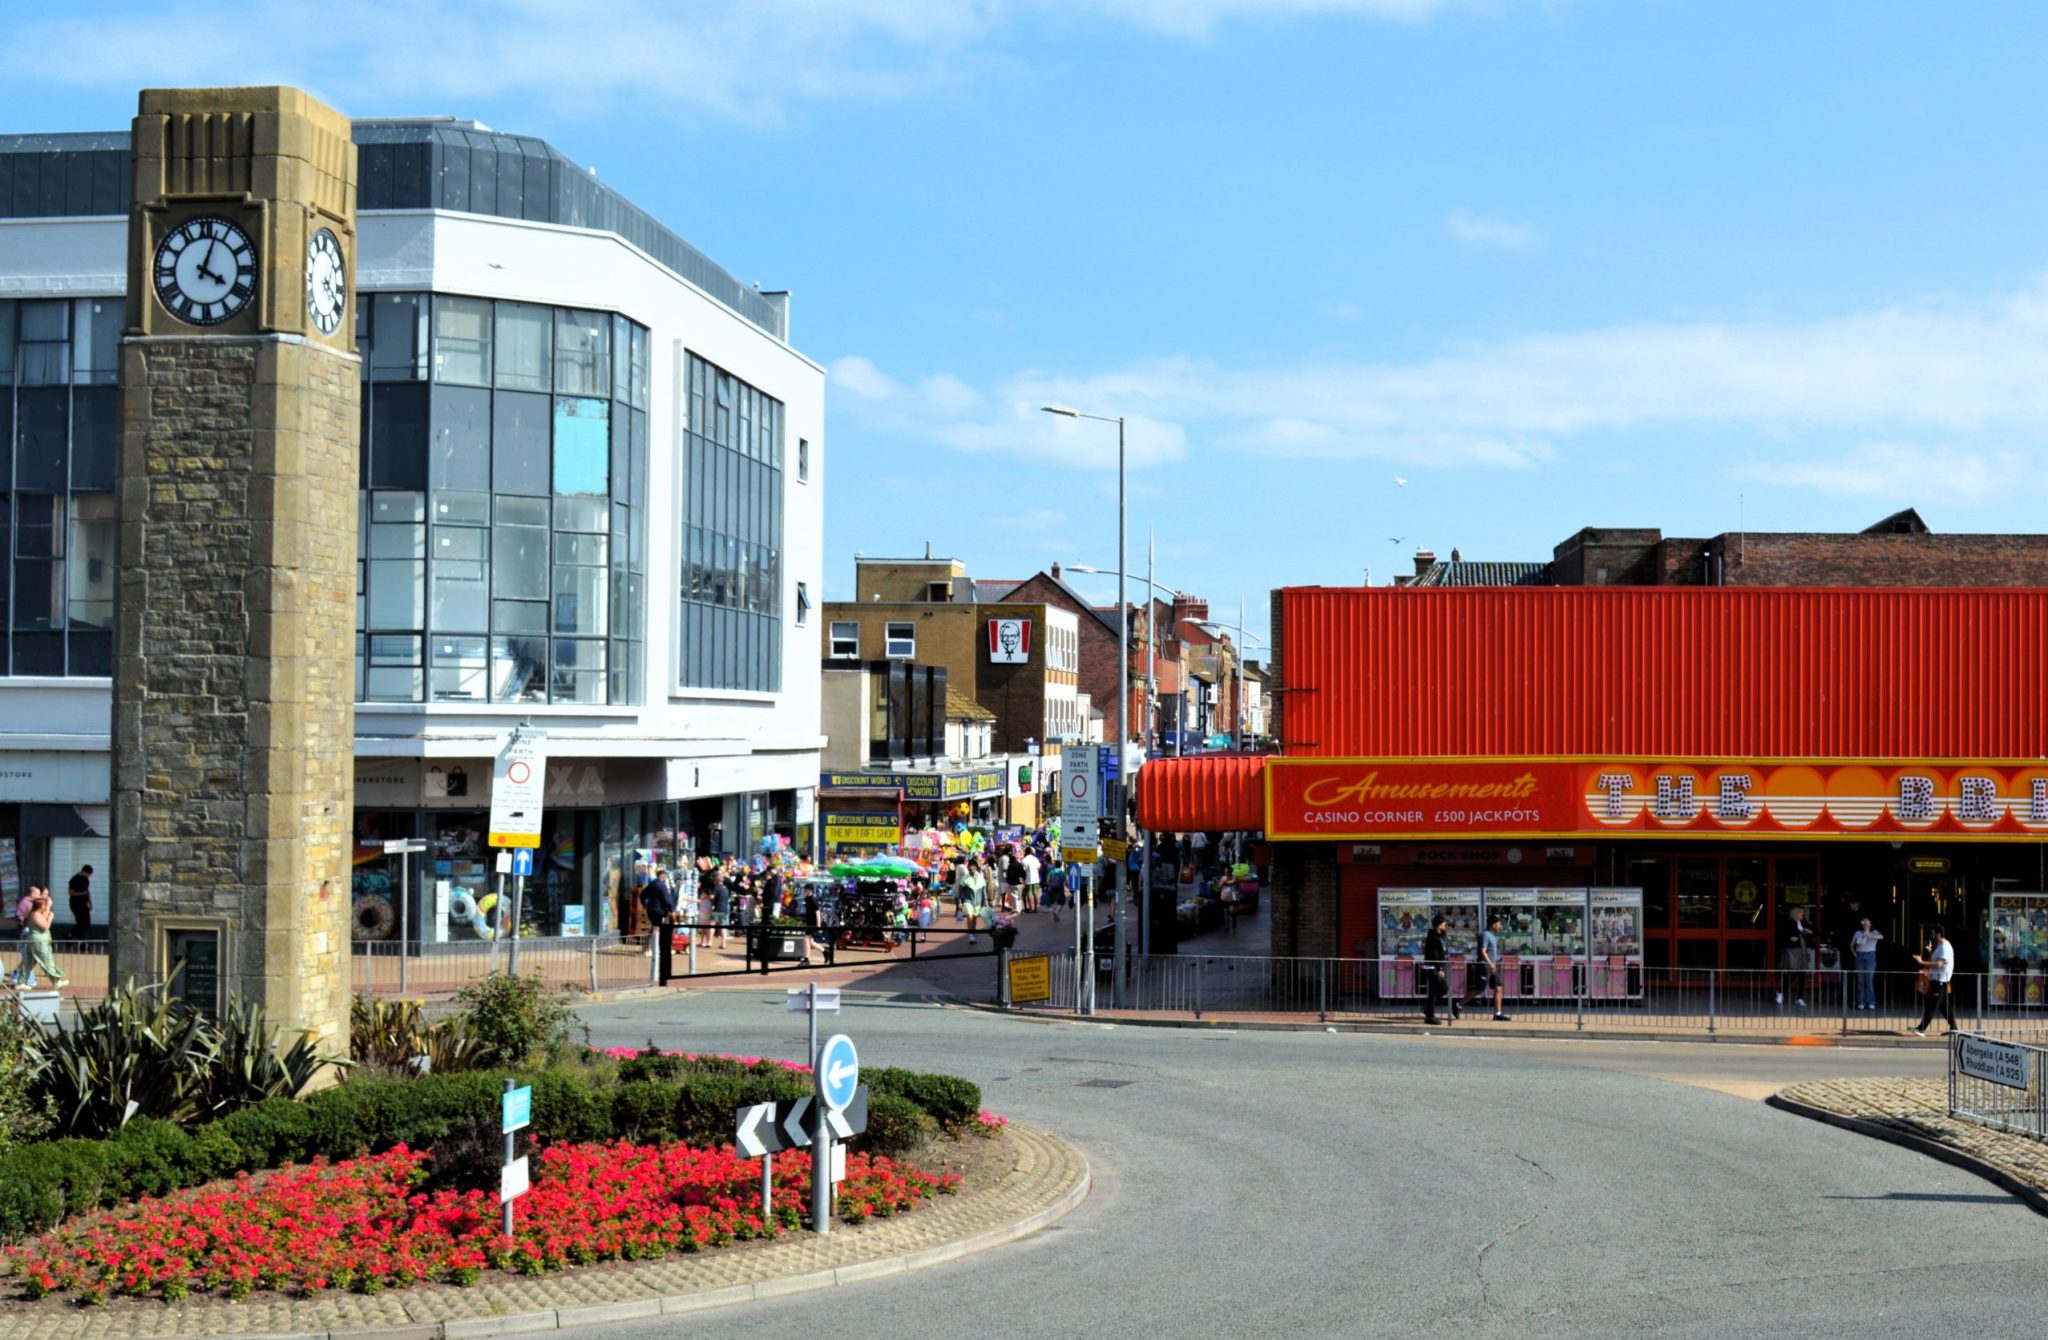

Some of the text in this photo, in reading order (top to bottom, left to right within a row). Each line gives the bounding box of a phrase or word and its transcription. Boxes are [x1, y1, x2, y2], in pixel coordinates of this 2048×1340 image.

[842, 776, 892, 785] DISCOUNT WORLD
[907, 777, 938, 786] DISCOUNT
[915, 787, 939, 796] WORLD
[1304, 771, 1538, 806] Amusements
[1598, 774, 1752, 818] THE
[836, 816, 888, 825] DISCOUNT WORLD
[1304, 809, 1540, 824] CASINO CORNER £500 JACKPOTS
[831, 828, 844, 838] THE
[877, 829, 896, 839] SHOP
[1417, 850, 1501, 860] ROCK SHOP
[1966, 1043, 1994, 1060] Abergele
[1966, 1056, 1995, 1074] Rhuddlan
